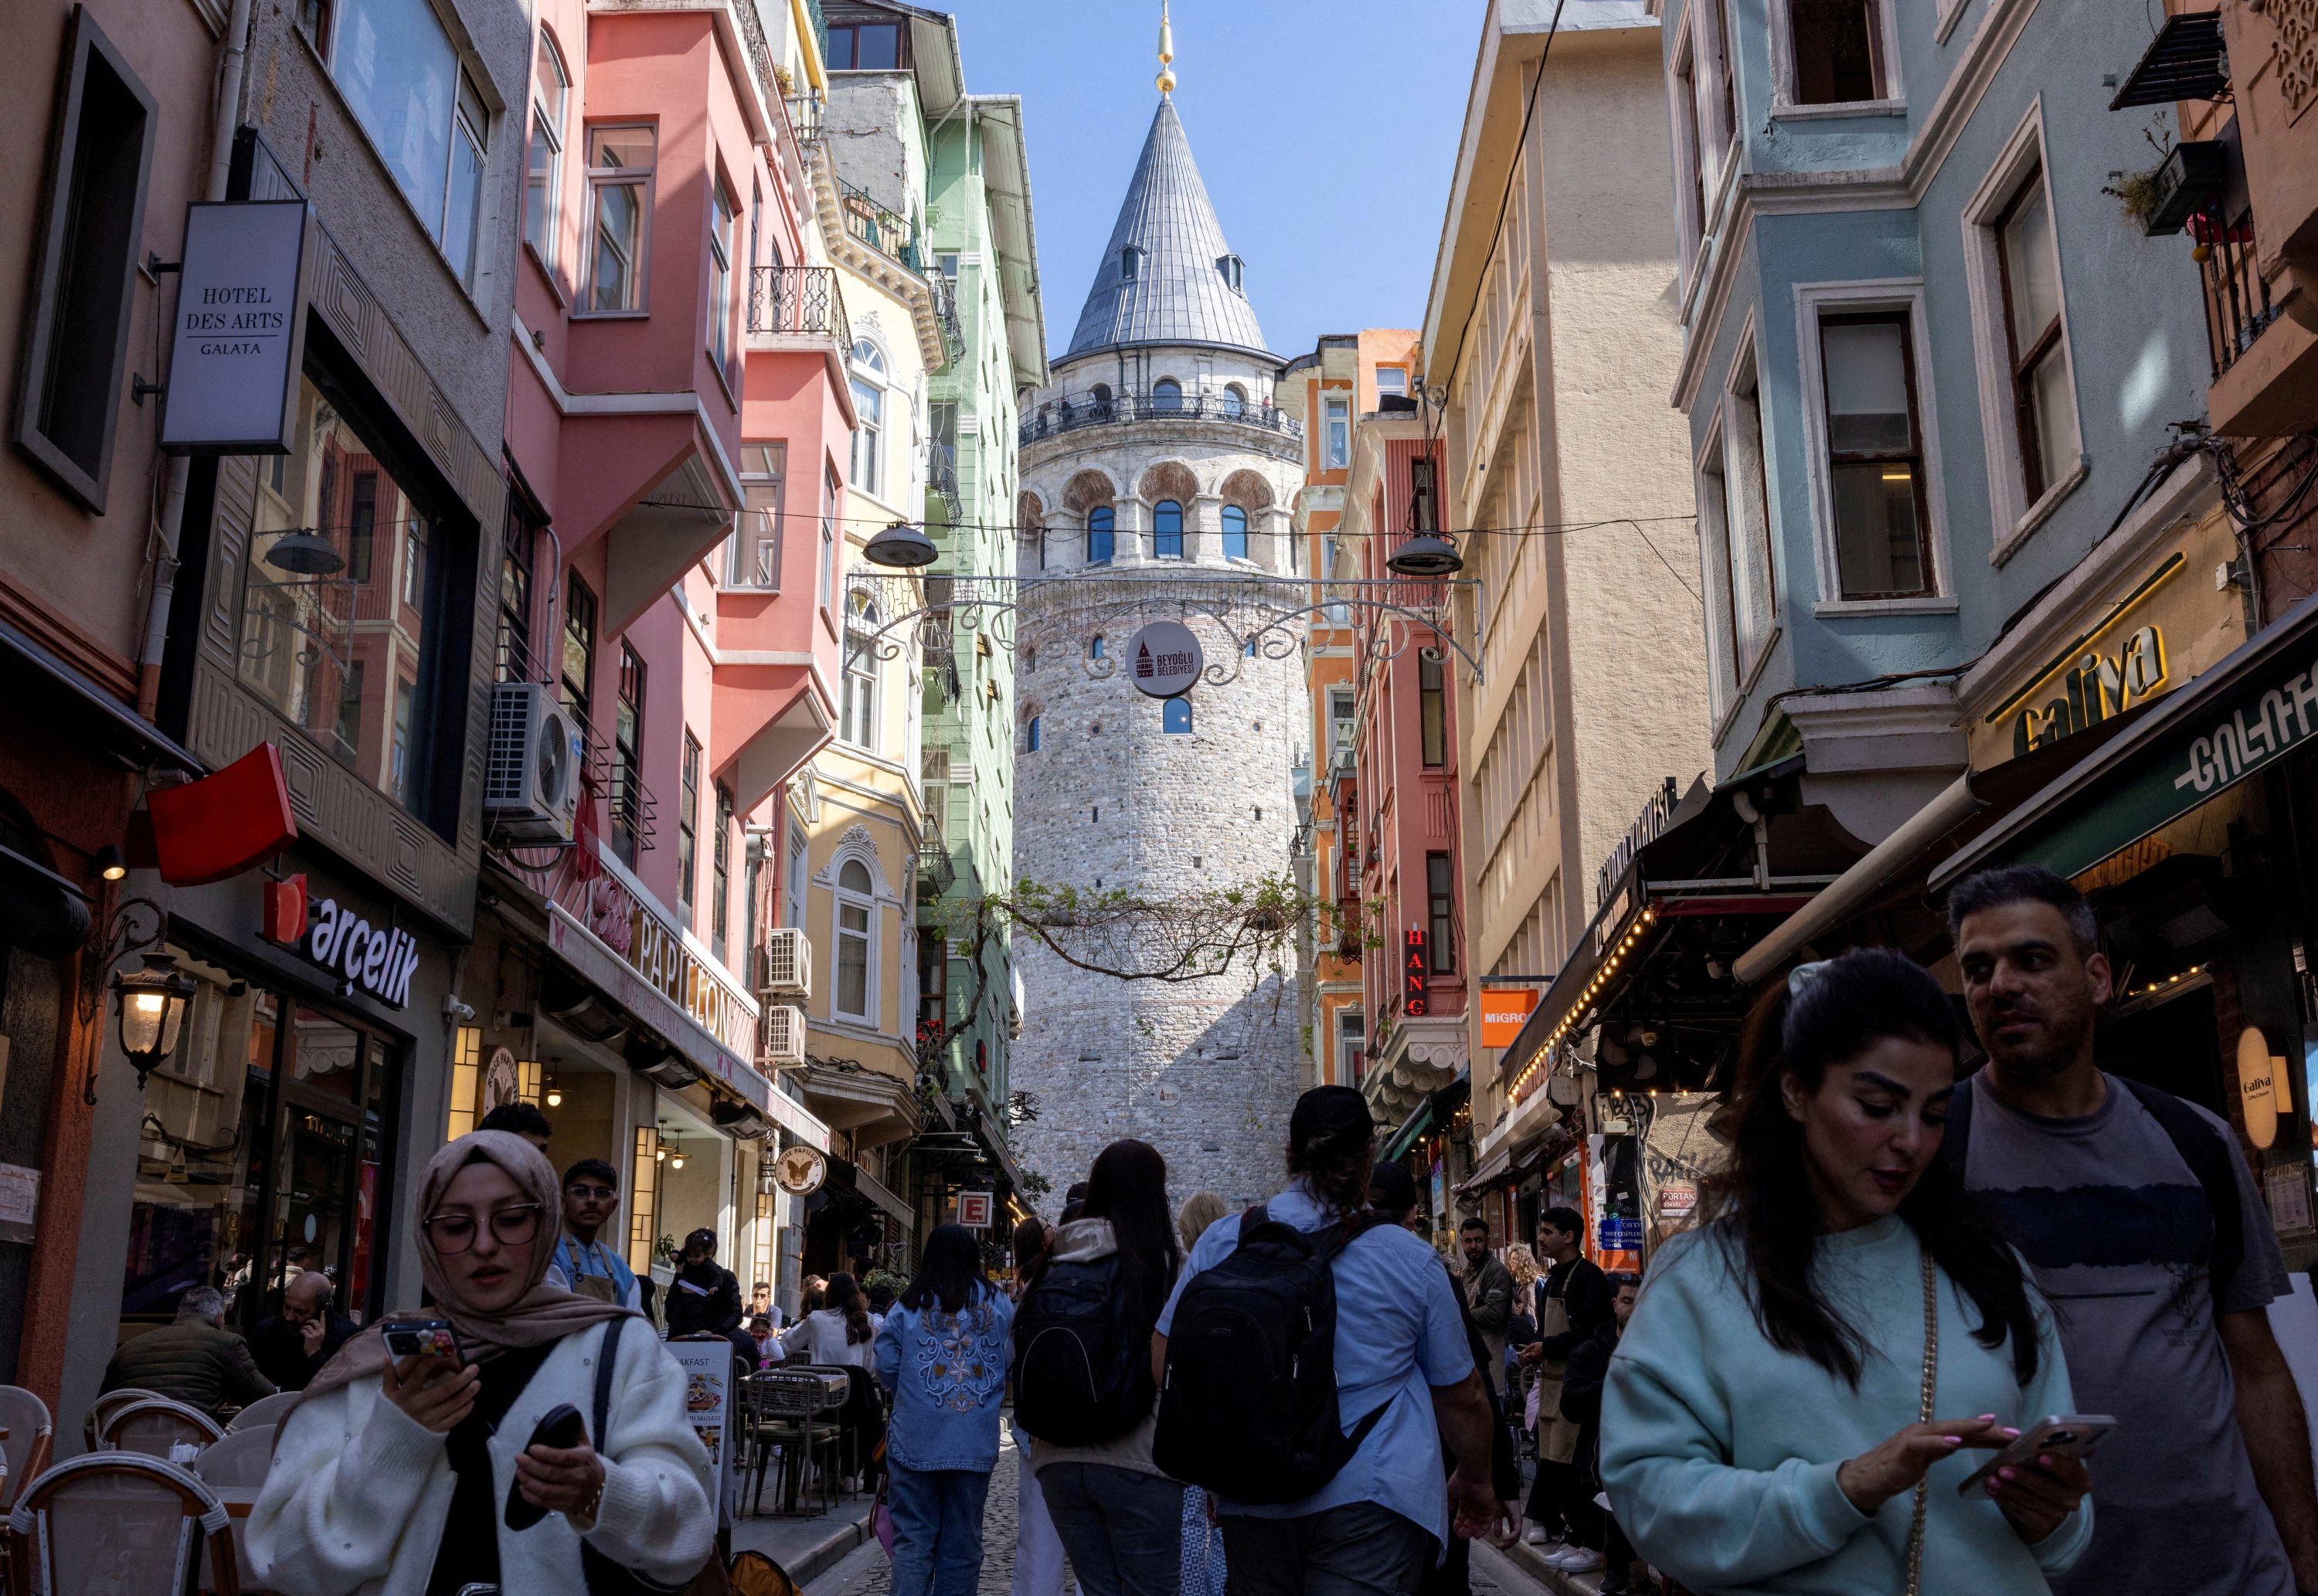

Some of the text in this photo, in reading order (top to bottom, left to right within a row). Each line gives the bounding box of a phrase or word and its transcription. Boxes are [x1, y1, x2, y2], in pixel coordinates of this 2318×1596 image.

[202, 287, 271, 304] HOTEL
[185, 312, 283, 329] DES ARTS
[201, 344, 260, 355] GALATA
[1157, 650, 1194, 667] BEYOĞLU
[1157, 664, 1195, 677] BELEDİYESİ
[2174, 659, 2318, 792] GALAT
[311, 898, 419, 1009] arçelik
[638, 912, 729, 1047] PAPILLON
[1407, 930, 1424, 1016] HANG
[1485, 1013, 1531, 1024] MiGRO
[488, 1053, 518, 1100] ROSE PAPILLON
[2244, 1076, 2271, 1094] Galiva
[779, 1148, 821, 1167] ROSE PAPILLON
[965, 1199, 983, 1220] E
[678, 1358, 710, 1367] AKFAST
